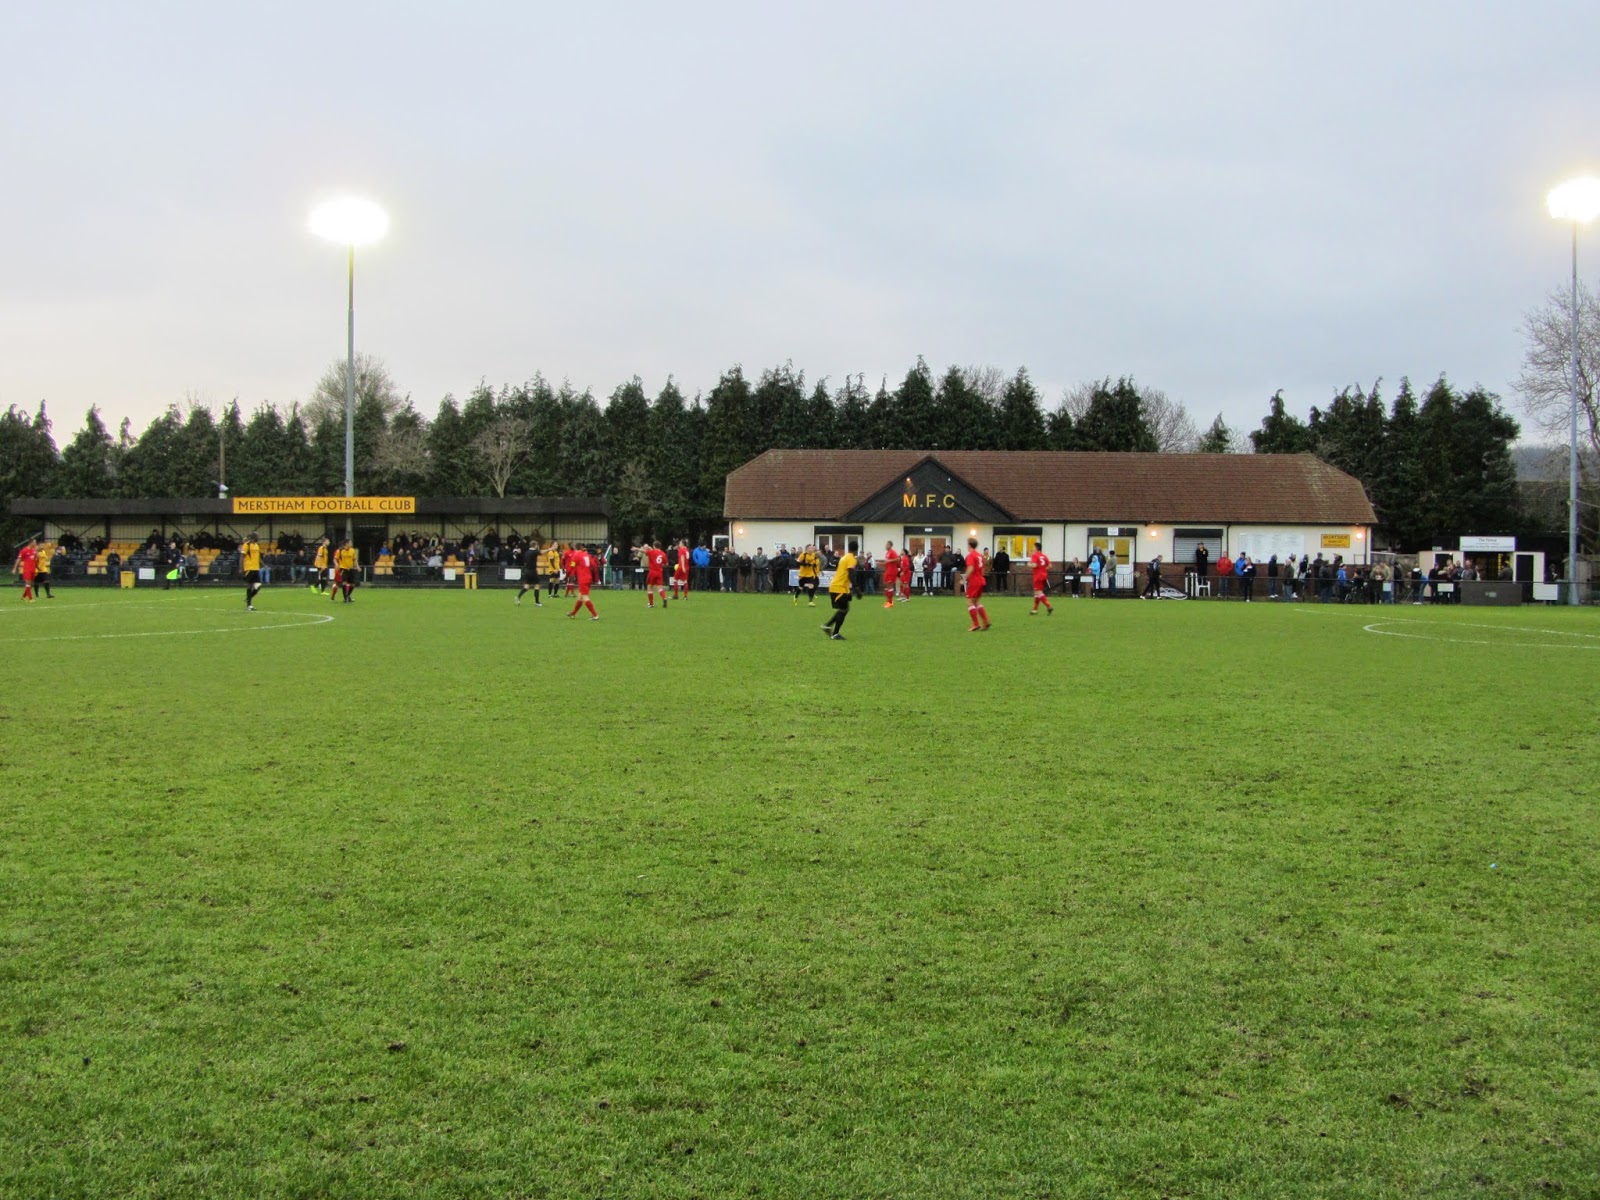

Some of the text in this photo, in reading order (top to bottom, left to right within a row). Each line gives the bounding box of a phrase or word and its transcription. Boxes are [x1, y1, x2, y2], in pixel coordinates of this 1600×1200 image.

[239, 500, 411, 511] MERSTHAM FOOTBALL CLUB
[903, 494, 955, 508] M.F.C
[656, 555, 663, 564] 6
[1039, 556, 1046, 566] 5
